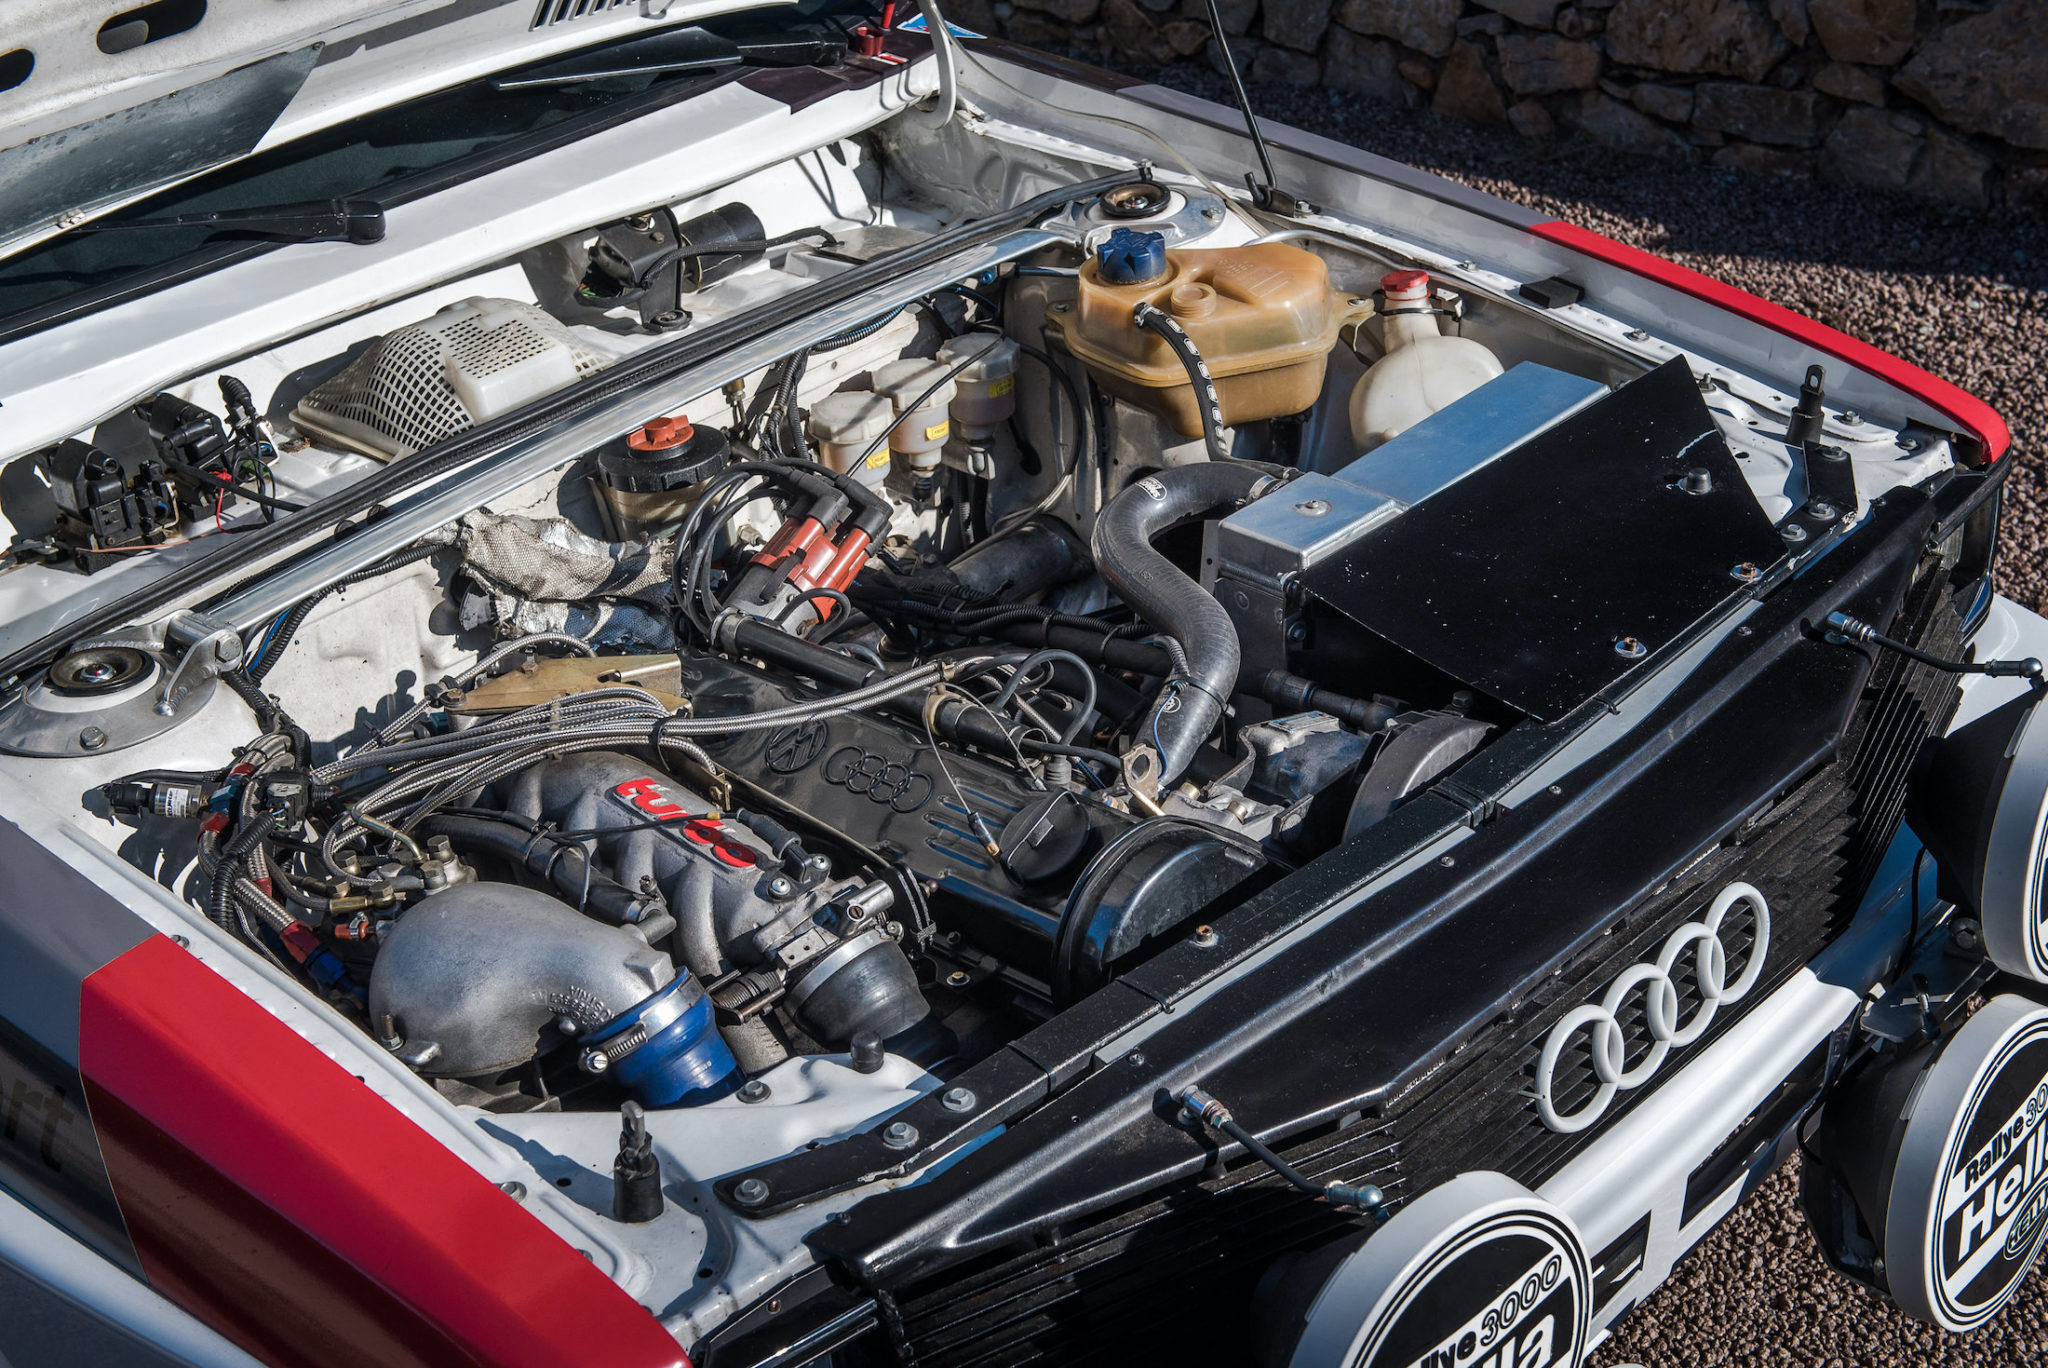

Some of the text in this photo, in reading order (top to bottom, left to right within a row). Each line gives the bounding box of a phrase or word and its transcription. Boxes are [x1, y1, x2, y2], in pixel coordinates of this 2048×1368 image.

[0, 1079, 75, 1173] rt
[1964, 1083, 2048, 1193] Rallye 30
[1958, 1118, 2048, 1262] Hell
[1480, 1254, 1562, 1347] 3000
